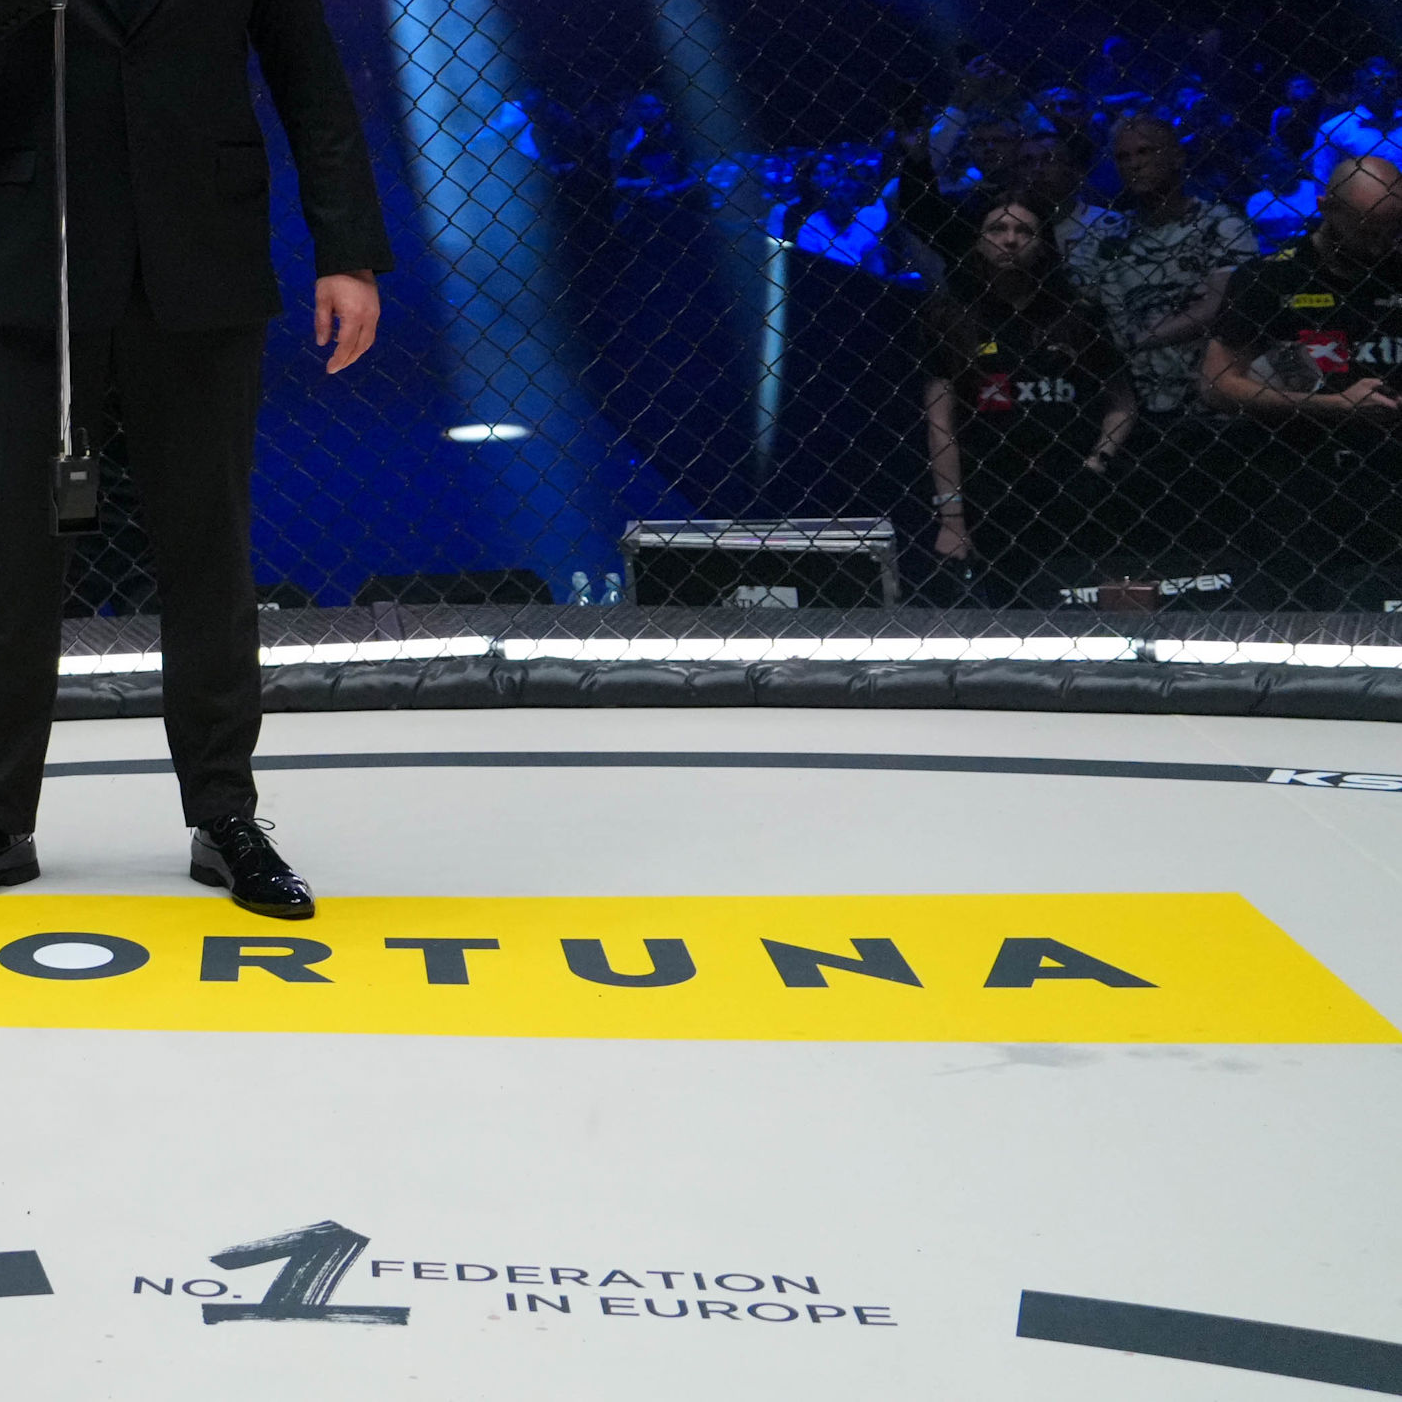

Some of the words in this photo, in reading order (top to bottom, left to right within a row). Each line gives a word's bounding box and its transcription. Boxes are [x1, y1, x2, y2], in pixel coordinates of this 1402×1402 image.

[1355, 335, 1402, 364] xt
[1015, 377, 1077, 403] xtb
[132, 1275, 242, 1301] NO.
[201, 1219, 411, 1326] 1
[370, 1259, 822, 1296] FEDERATION
[506, 1292, 572, 1315] IN
[599, 1295, 899, 1327] EUROPE
